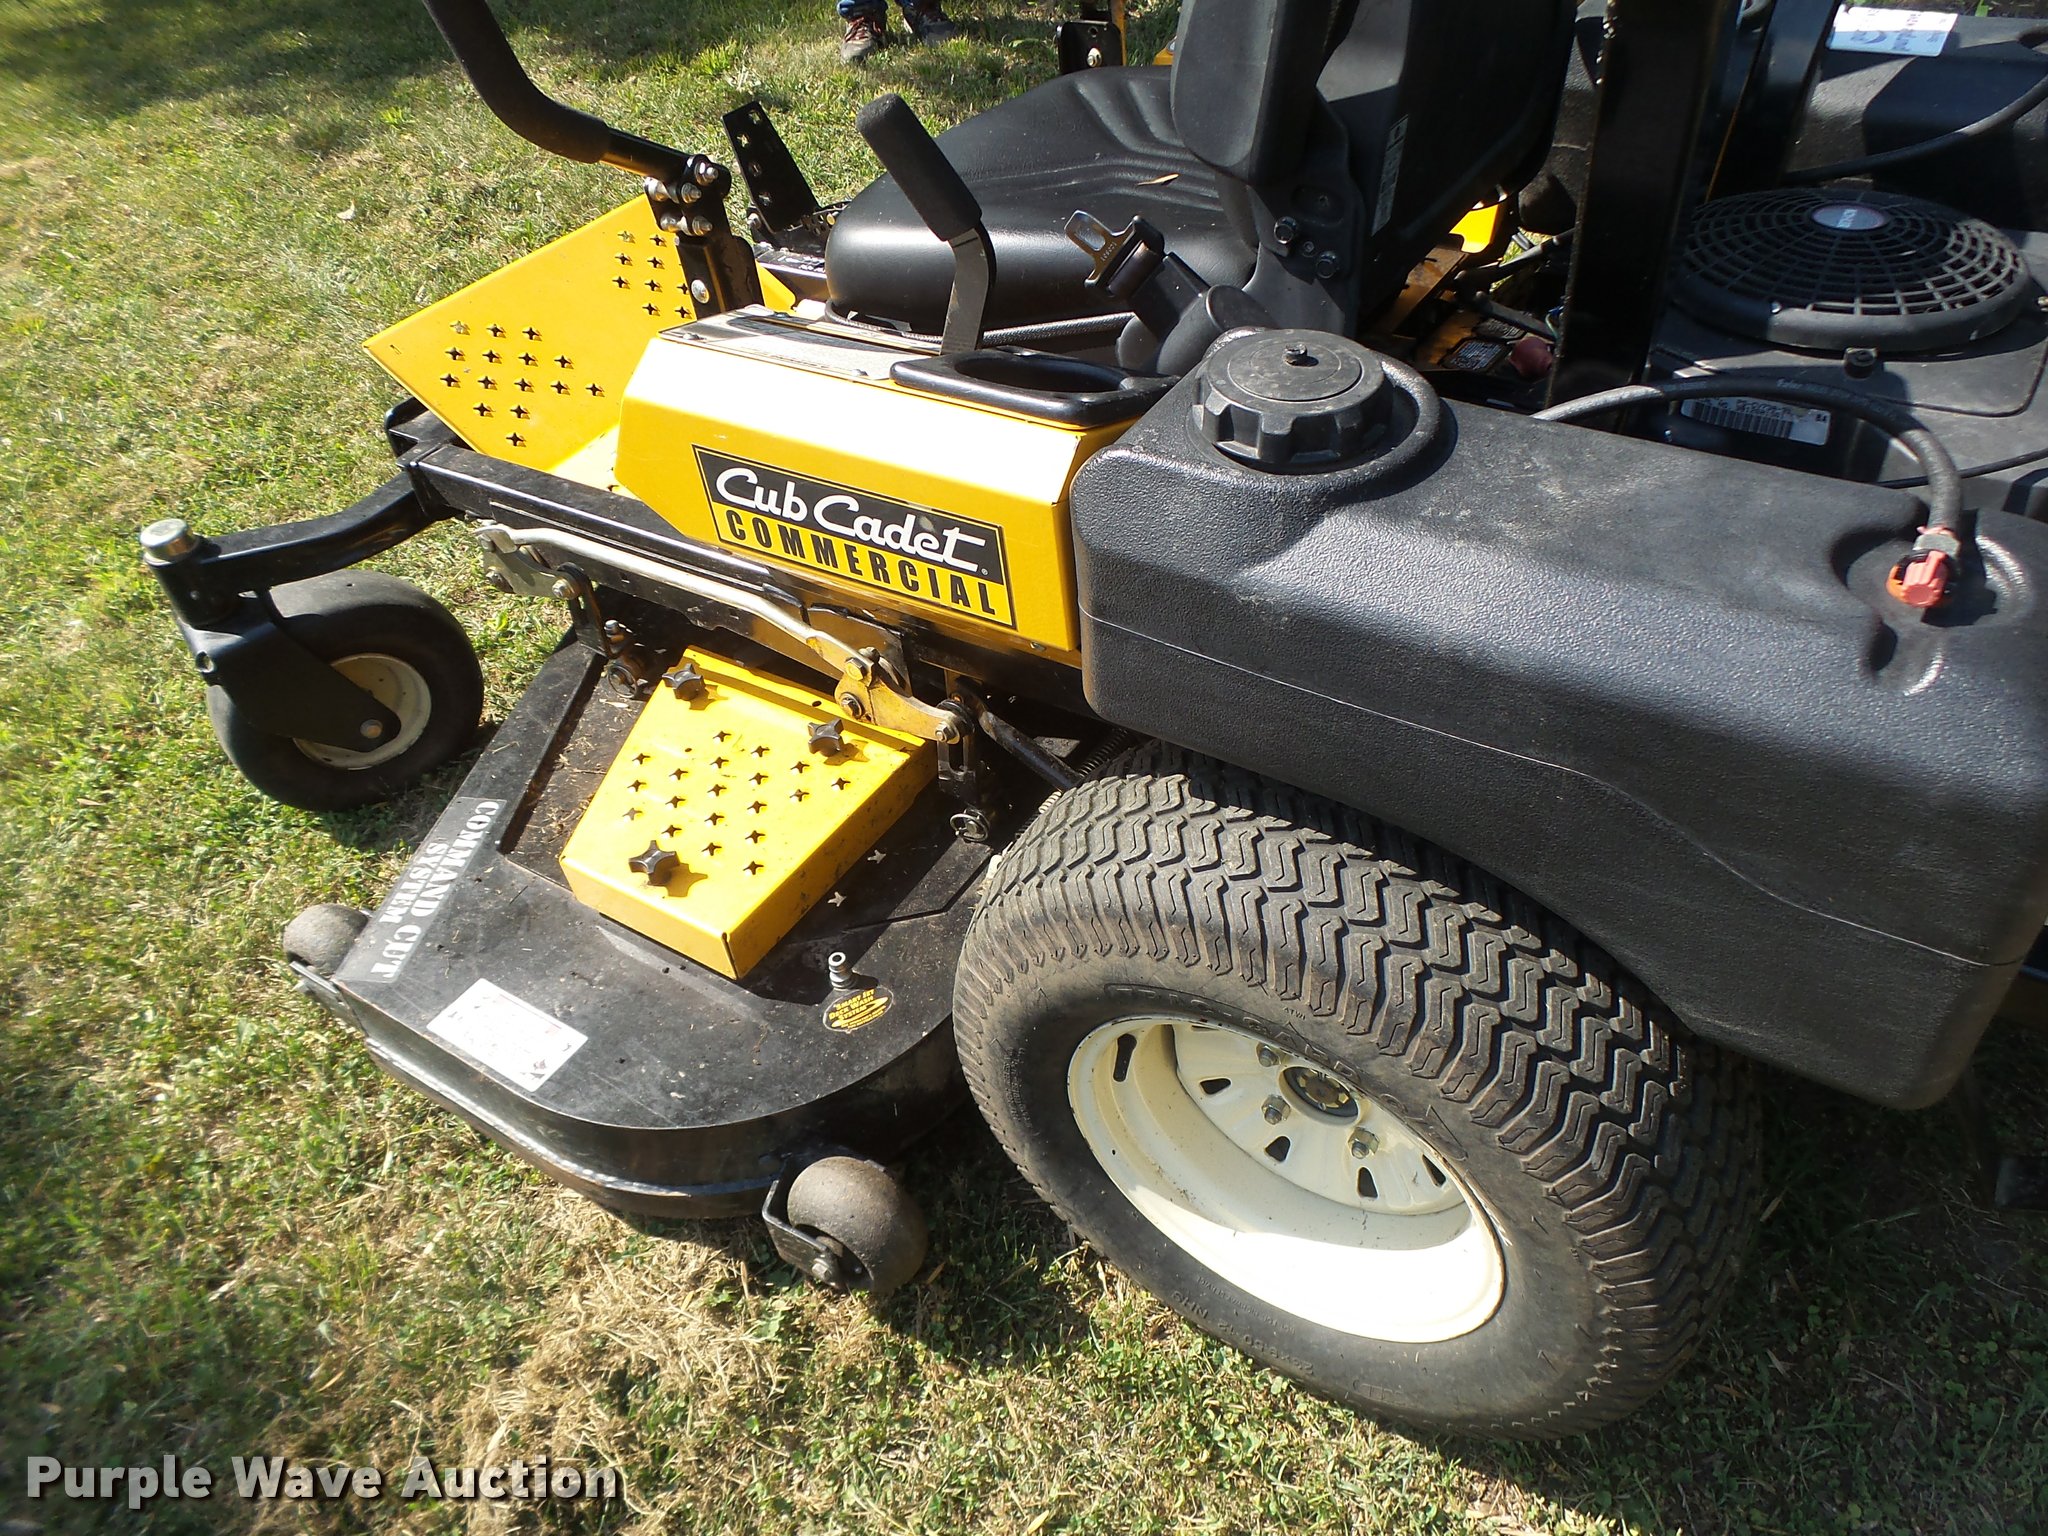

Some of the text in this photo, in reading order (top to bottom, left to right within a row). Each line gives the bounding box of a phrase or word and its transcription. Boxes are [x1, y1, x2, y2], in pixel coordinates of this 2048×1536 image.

[715, 467, 986, 573] Cub Cadet
[725, 509, 996, 616] COMMERCIAL
[370, 801, 500, 979] COMMAND CUT
[379, 842, 449, 924] SYSTEM
[850, 995, 874, 1010] WASH
